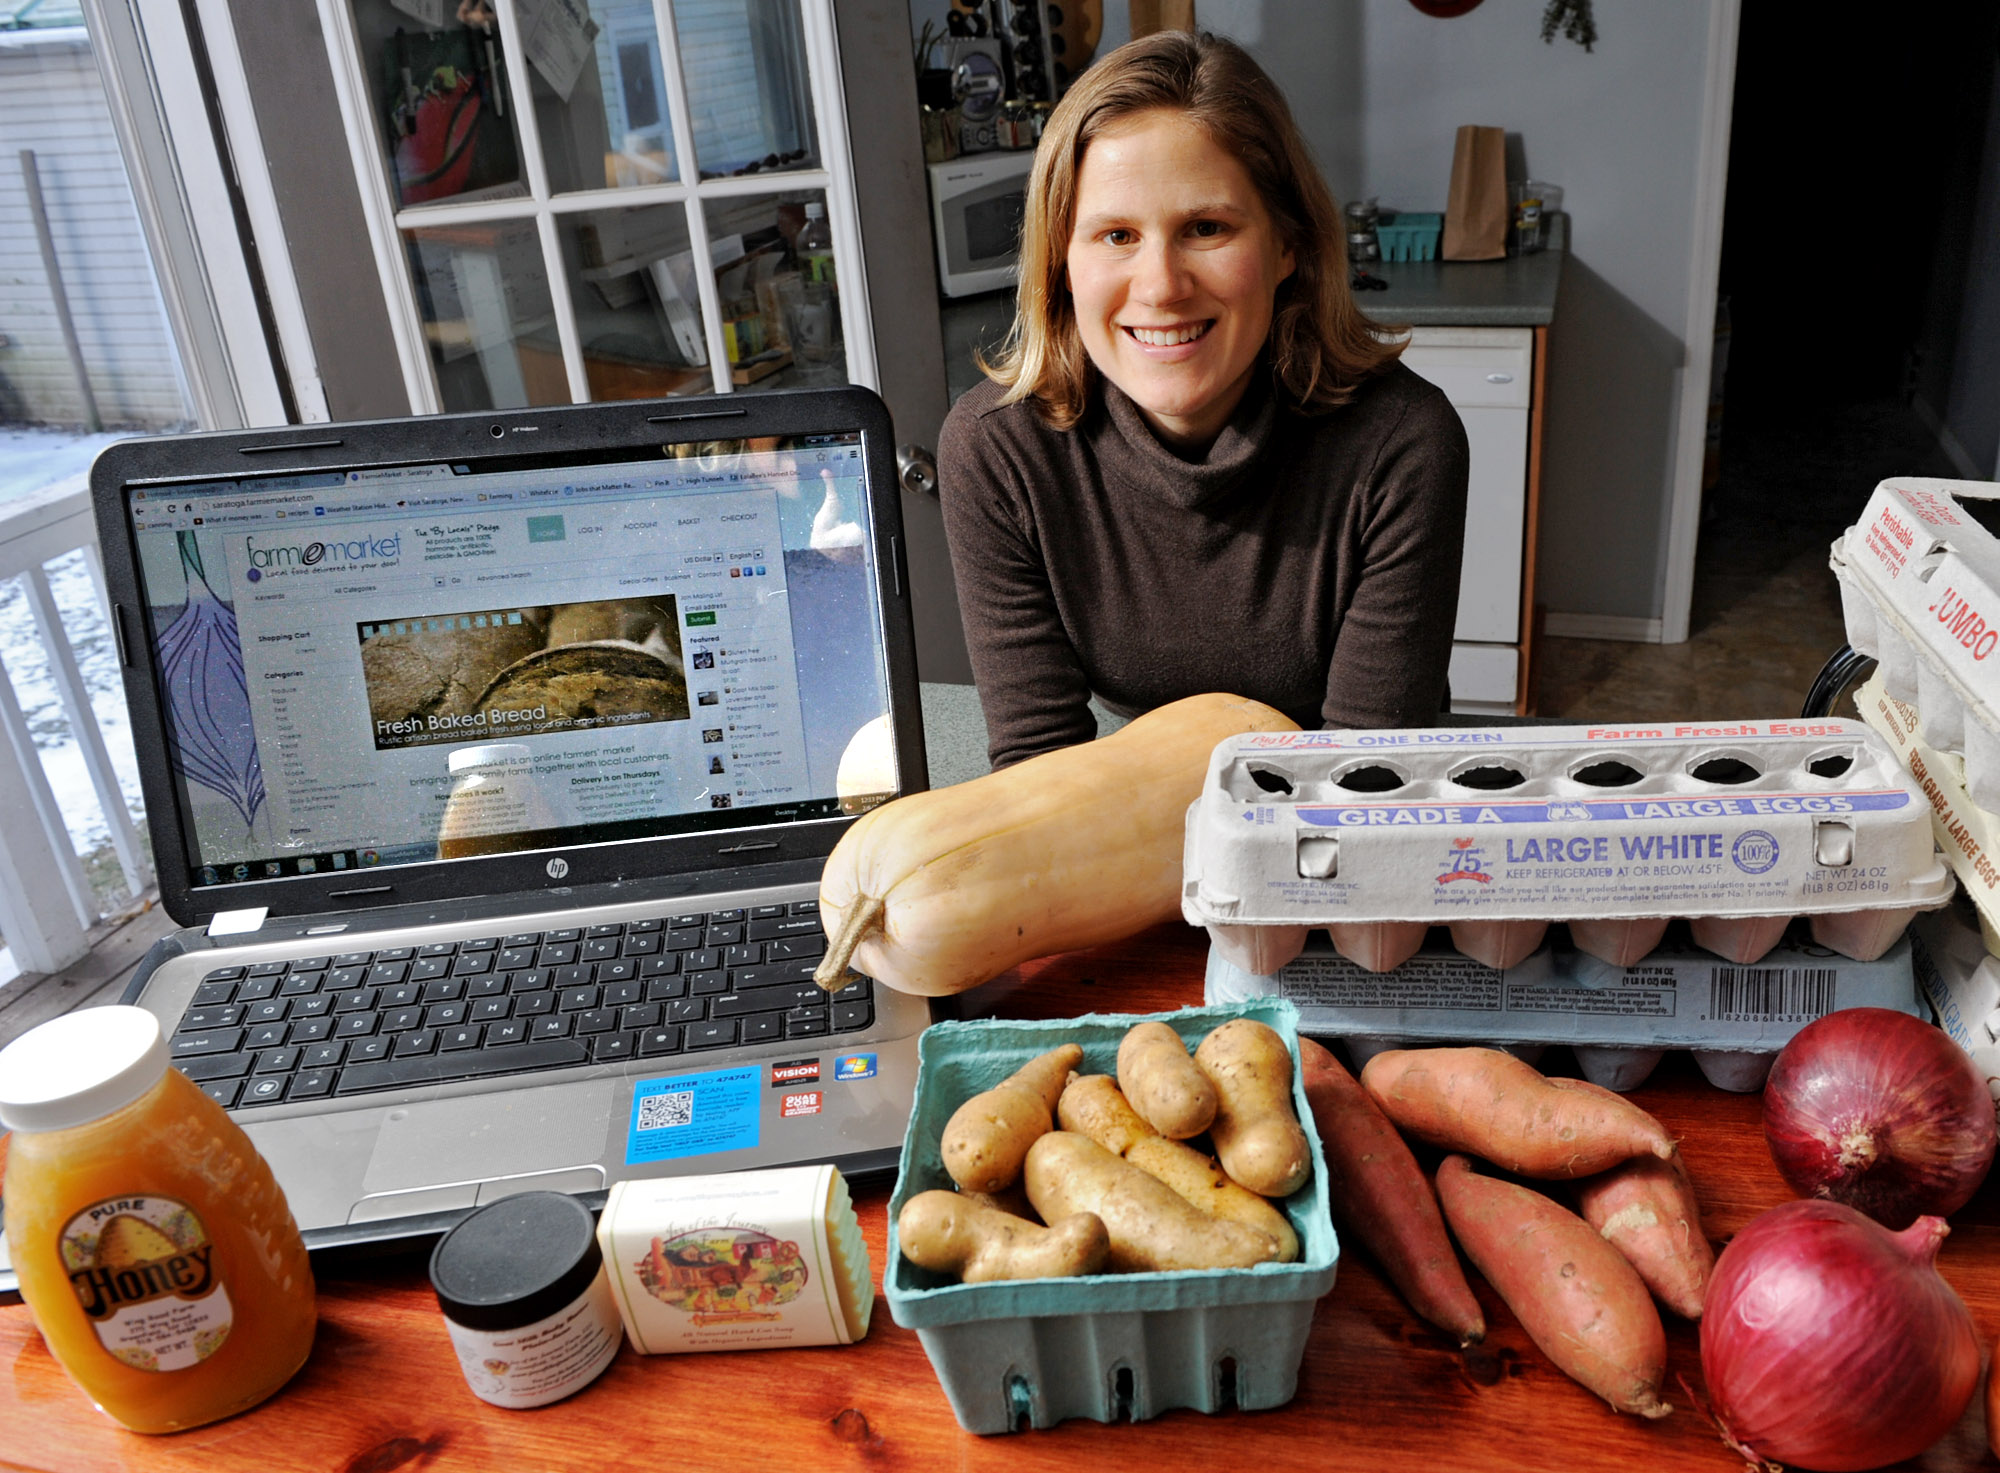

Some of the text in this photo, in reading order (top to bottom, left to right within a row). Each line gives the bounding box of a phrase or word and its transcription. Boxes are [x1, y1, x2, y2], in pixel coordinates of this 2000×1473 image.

[686, 477, 700, 485] High
[720, 513, 758, 523] CHECKOUT
[577, 526, 594, 534] LOG
[623, 521, 658, 531] ACCOUNT
[1880, 507, 1913, 550] Perishable
[729, 552, 752, 561] English
[258, 630, 311, 643] Shopping Cart
[690, 635, 720, 644] Featured
[264, 670, 304, 680] Categories
[376, 704, 546, 736] Fresh Baked Bread
[378, 716, 606, 745] Rustic artisan bread baked fresh using local and organic
[1587, 723, 1844, 740] Farm Fresh Eggs
[1357, 733, 1504, 746] ONE DOZEN
[533, 751, 561, 762] online
[563, 748, 600, 760] farmers'
[602, 745, 636, 756] market
[409, 752, 673, 787] bringing farms together with local customers.
[571, 776, 602, 786] Delivery
[623, 770, 661, 780] Thursdays
[481, 787, 505, 796] work?
[1622, 796, 1854, 819] LARGE EGGS
[1337, 807, 1503, 826] GRADE A
[1908, 747, 2000, 890] FRESH GRADE A LARGE EGGS
[1506, 836, 1609, 863] LARGE
[1619, 833, 1723, 861] WHITE
[1741, 844, 1771, 861] 100%
[1506, 868, 1532, 879] KEEP
[1535, 867, 1613, 879] REFRIGERATED
[1616, 866, 1629, 877] AT
[1633, 866, 1650, 877] OR
[1653, 864, 1695, 877] BELOW
[1805, 867, 1888, 882] NET WT 24 OZ
[1433, 886, 1448, 895] We
[1450, 887, 1464, 895] are
[1480, 887, 1496, 895] sure
[1499, 885, 1515, 894] that
[1517, 886, 1533, 896] you
[1535, 885, 1550, 893] will
[1552, 885, 1567, 893] like
[1586, 884, 1618, 895] product
[1619, 884, 1636, 893] that
[1653, 883, 1696, 894] guarantee
[1698, 880, 1745, 891] satisfaction
[1759, 880, 1772, 888] we
[1774, 879, 1789, 887] will
[1802, 880, 1890, 896] (1LB 8 OZ) 681g
[1612, 893, 1649, 904] complete
[1652, 891, 1699, 901] satisfaction
[1711, 892, 1725, 900] our
[1626, 967, 1675, 976] NET WT 24 OZ
[1660, 978, 1677, 988] 681g
[1917, 955, 1953, 1012] BROWN
[774, 1066, 818, 1079] VISION
[838, 1071, 869, 1080] Windows
[642, 1073, 753, 1094] TEXT BETTER TO 474747
[785, 1093, 817, 1102] QUAD
[785, 1098, 817, 1108] CORE
[89, 1199, 145, 1221] PURE
[70, 1244, 213, 1317] Honey
